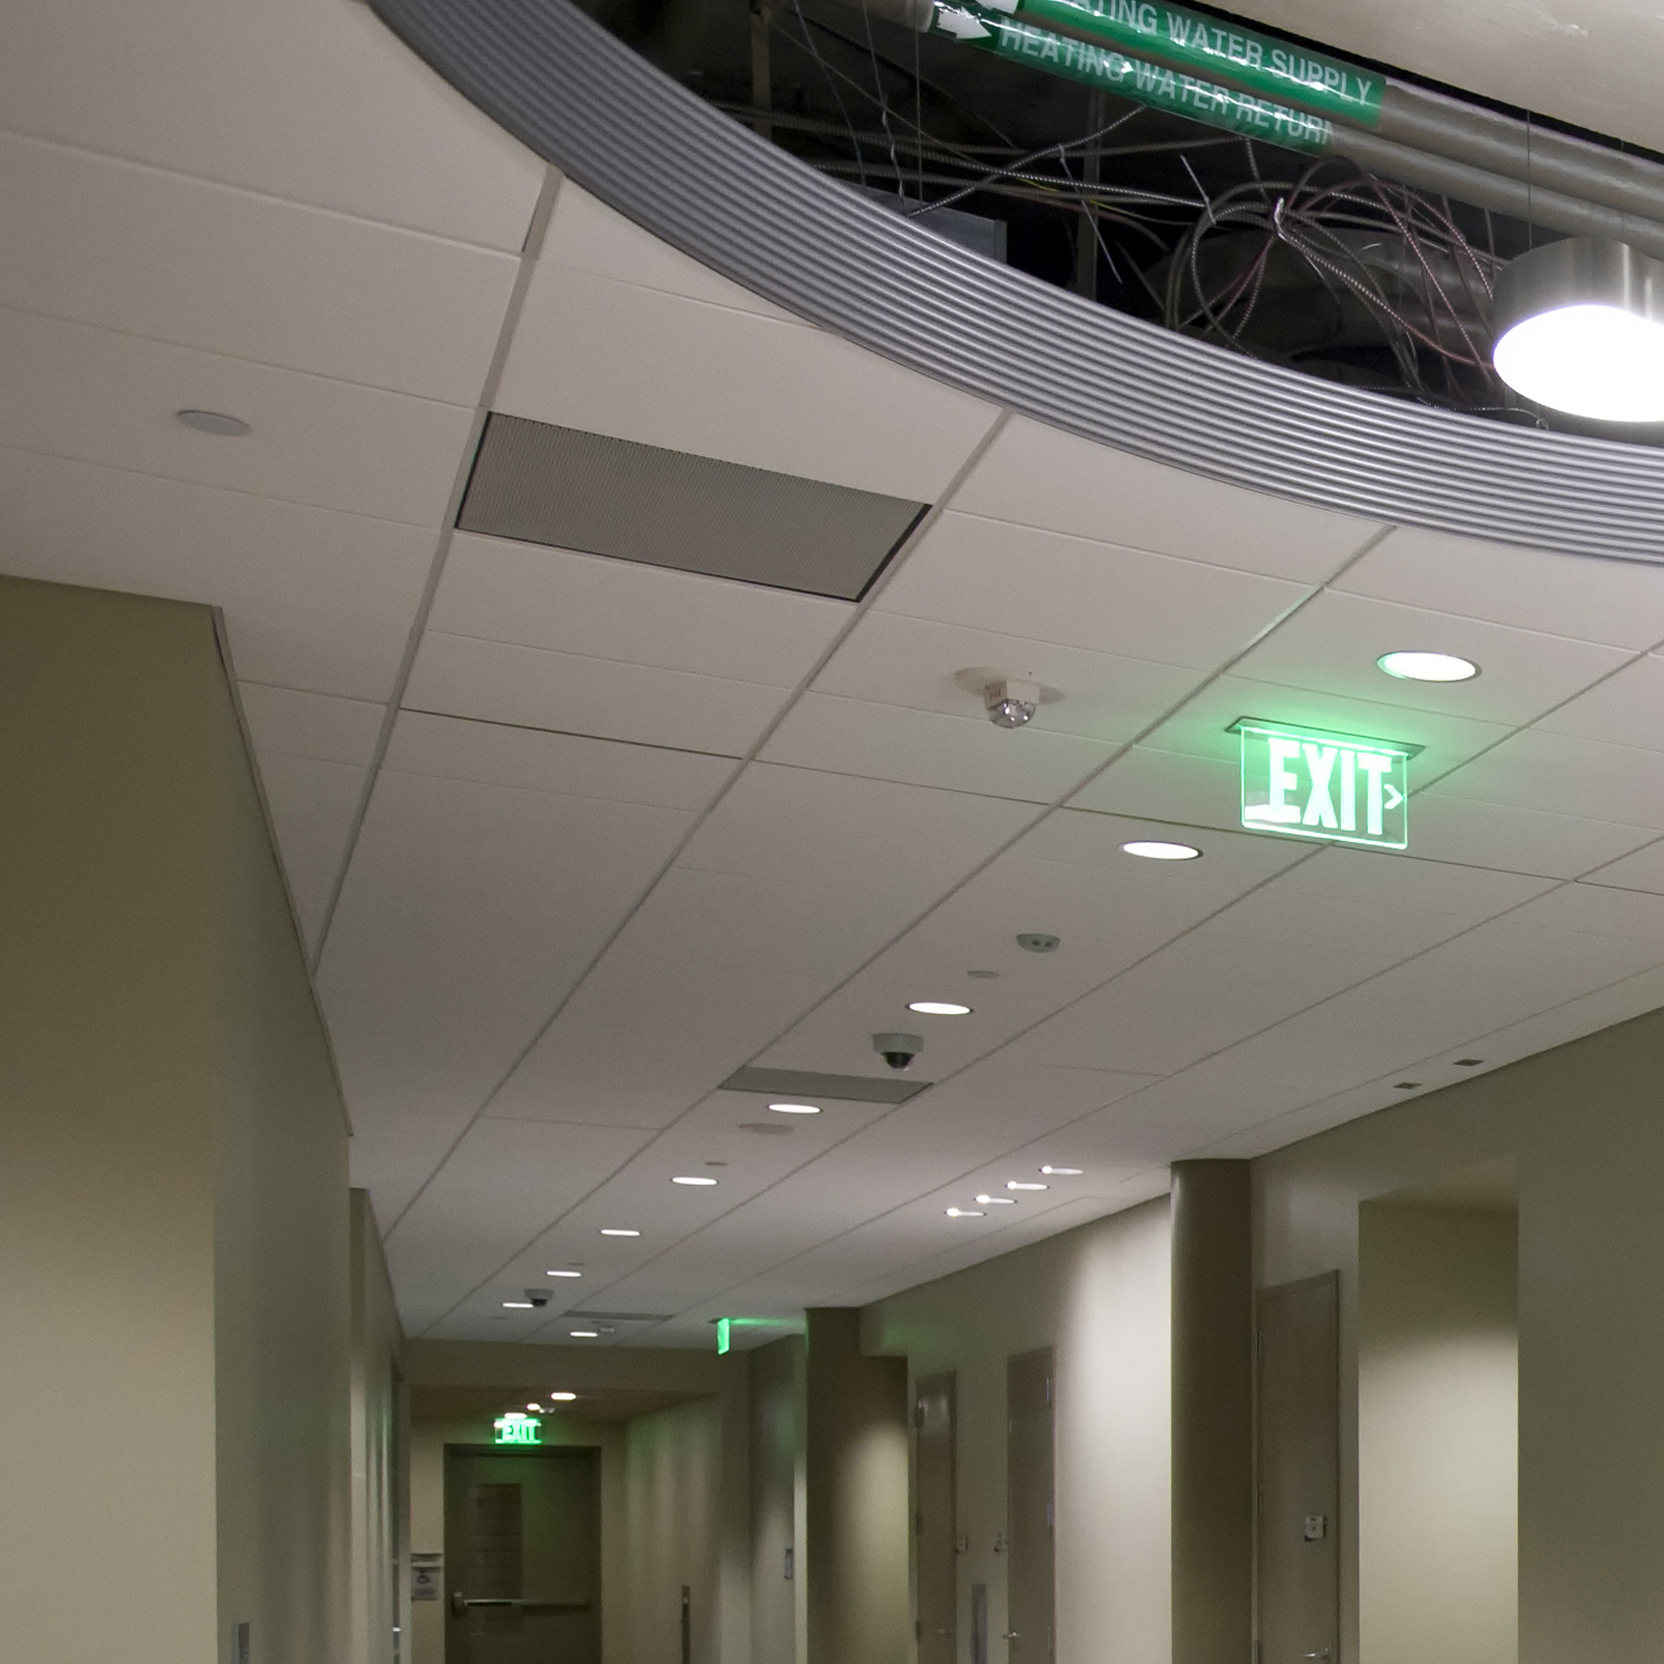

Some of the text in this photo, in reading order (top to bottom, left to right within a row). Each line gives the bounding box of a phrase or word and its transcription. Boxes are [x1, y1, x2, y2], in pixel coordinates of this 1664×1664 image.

[1001, 15, 1125, 83] HEATING
[1135, 60, 1230, 115] WATER
[1167, 12, 1263, 70] WATER
[1270, 49, 1371, 105] SUPPLY
[1267, 738, 1392, 835] EXIT
[502, 1419, 536, 1442] EXIT
